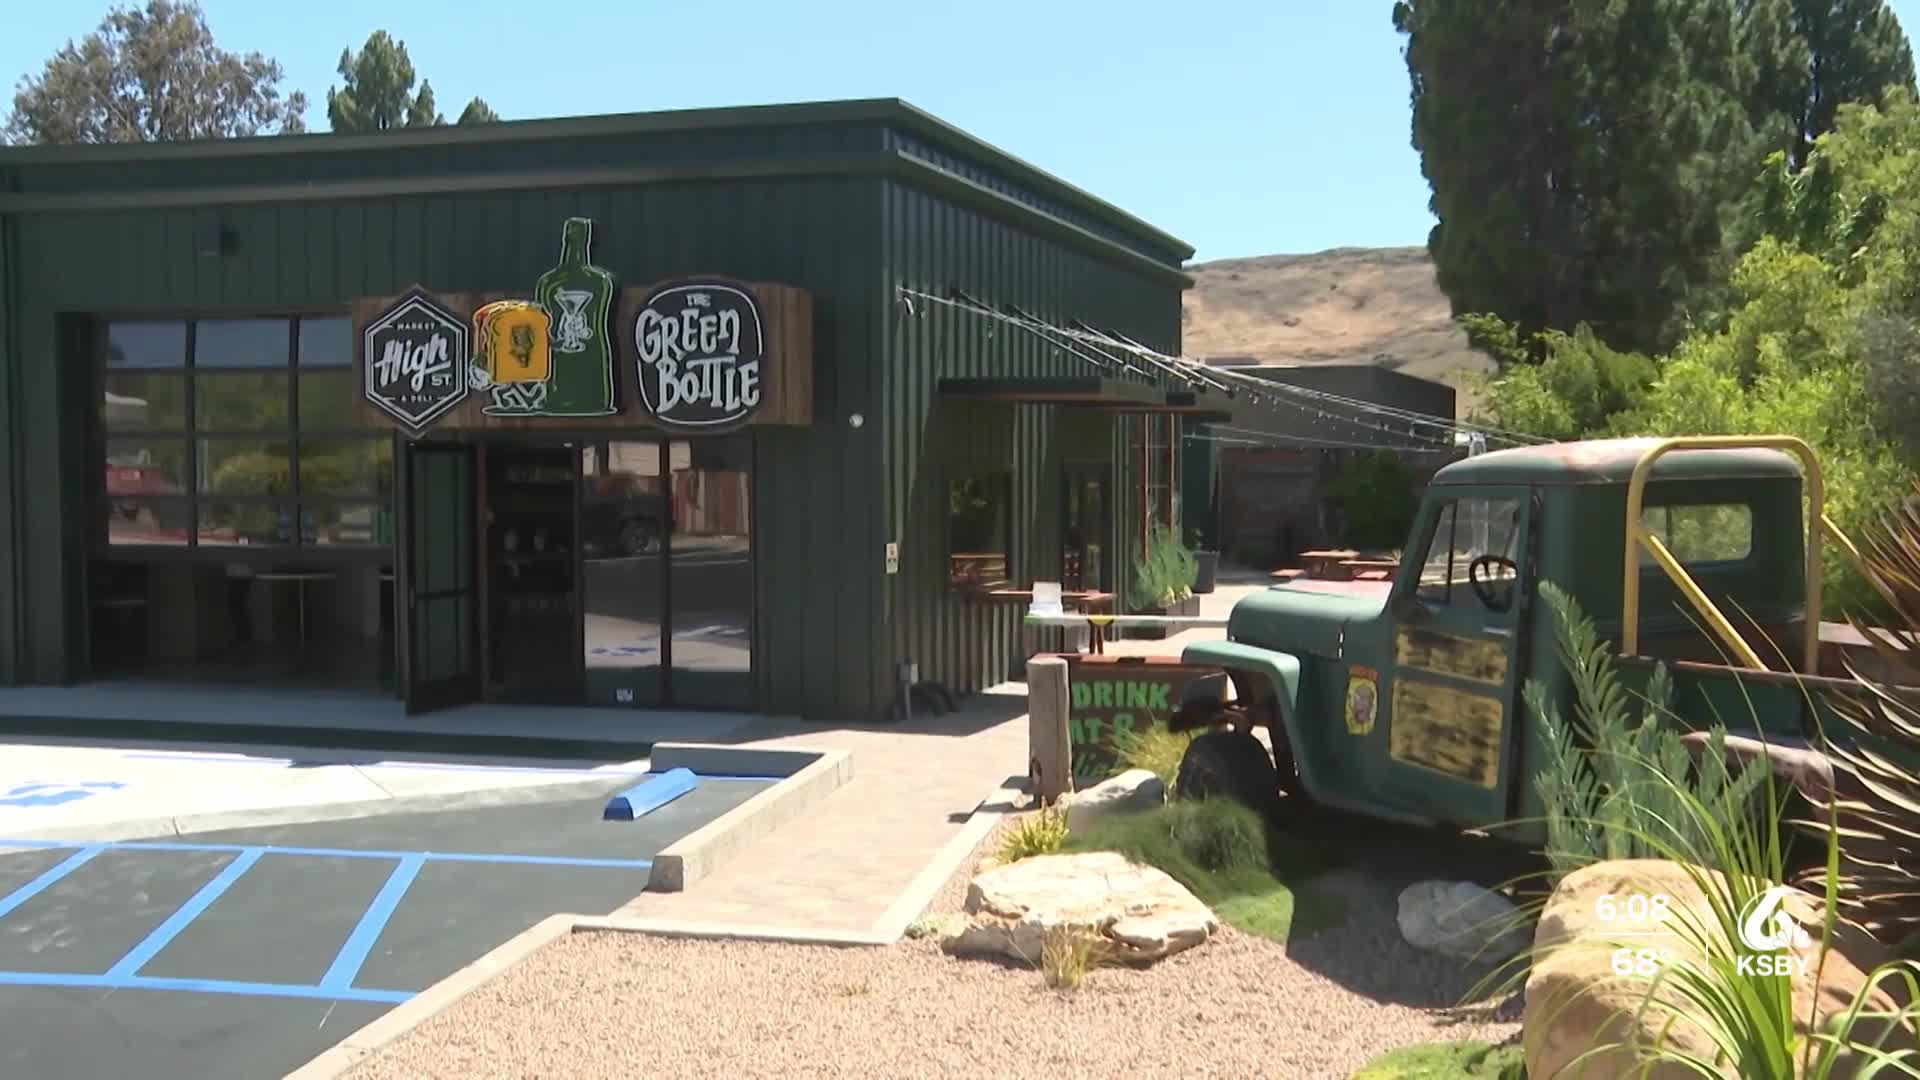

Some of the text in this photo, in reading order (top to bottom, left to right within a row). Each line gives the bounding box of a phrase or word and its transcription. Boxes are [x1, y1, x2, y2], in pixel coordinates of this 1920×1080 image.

[397, 322, 435, 331] MARKET
[374, 332, 452, 392] High
[410, 394, 432, 402] DELI
[1071, 680, 1170, 709] DRINK
[1070, 718, 1100, 745] AT
